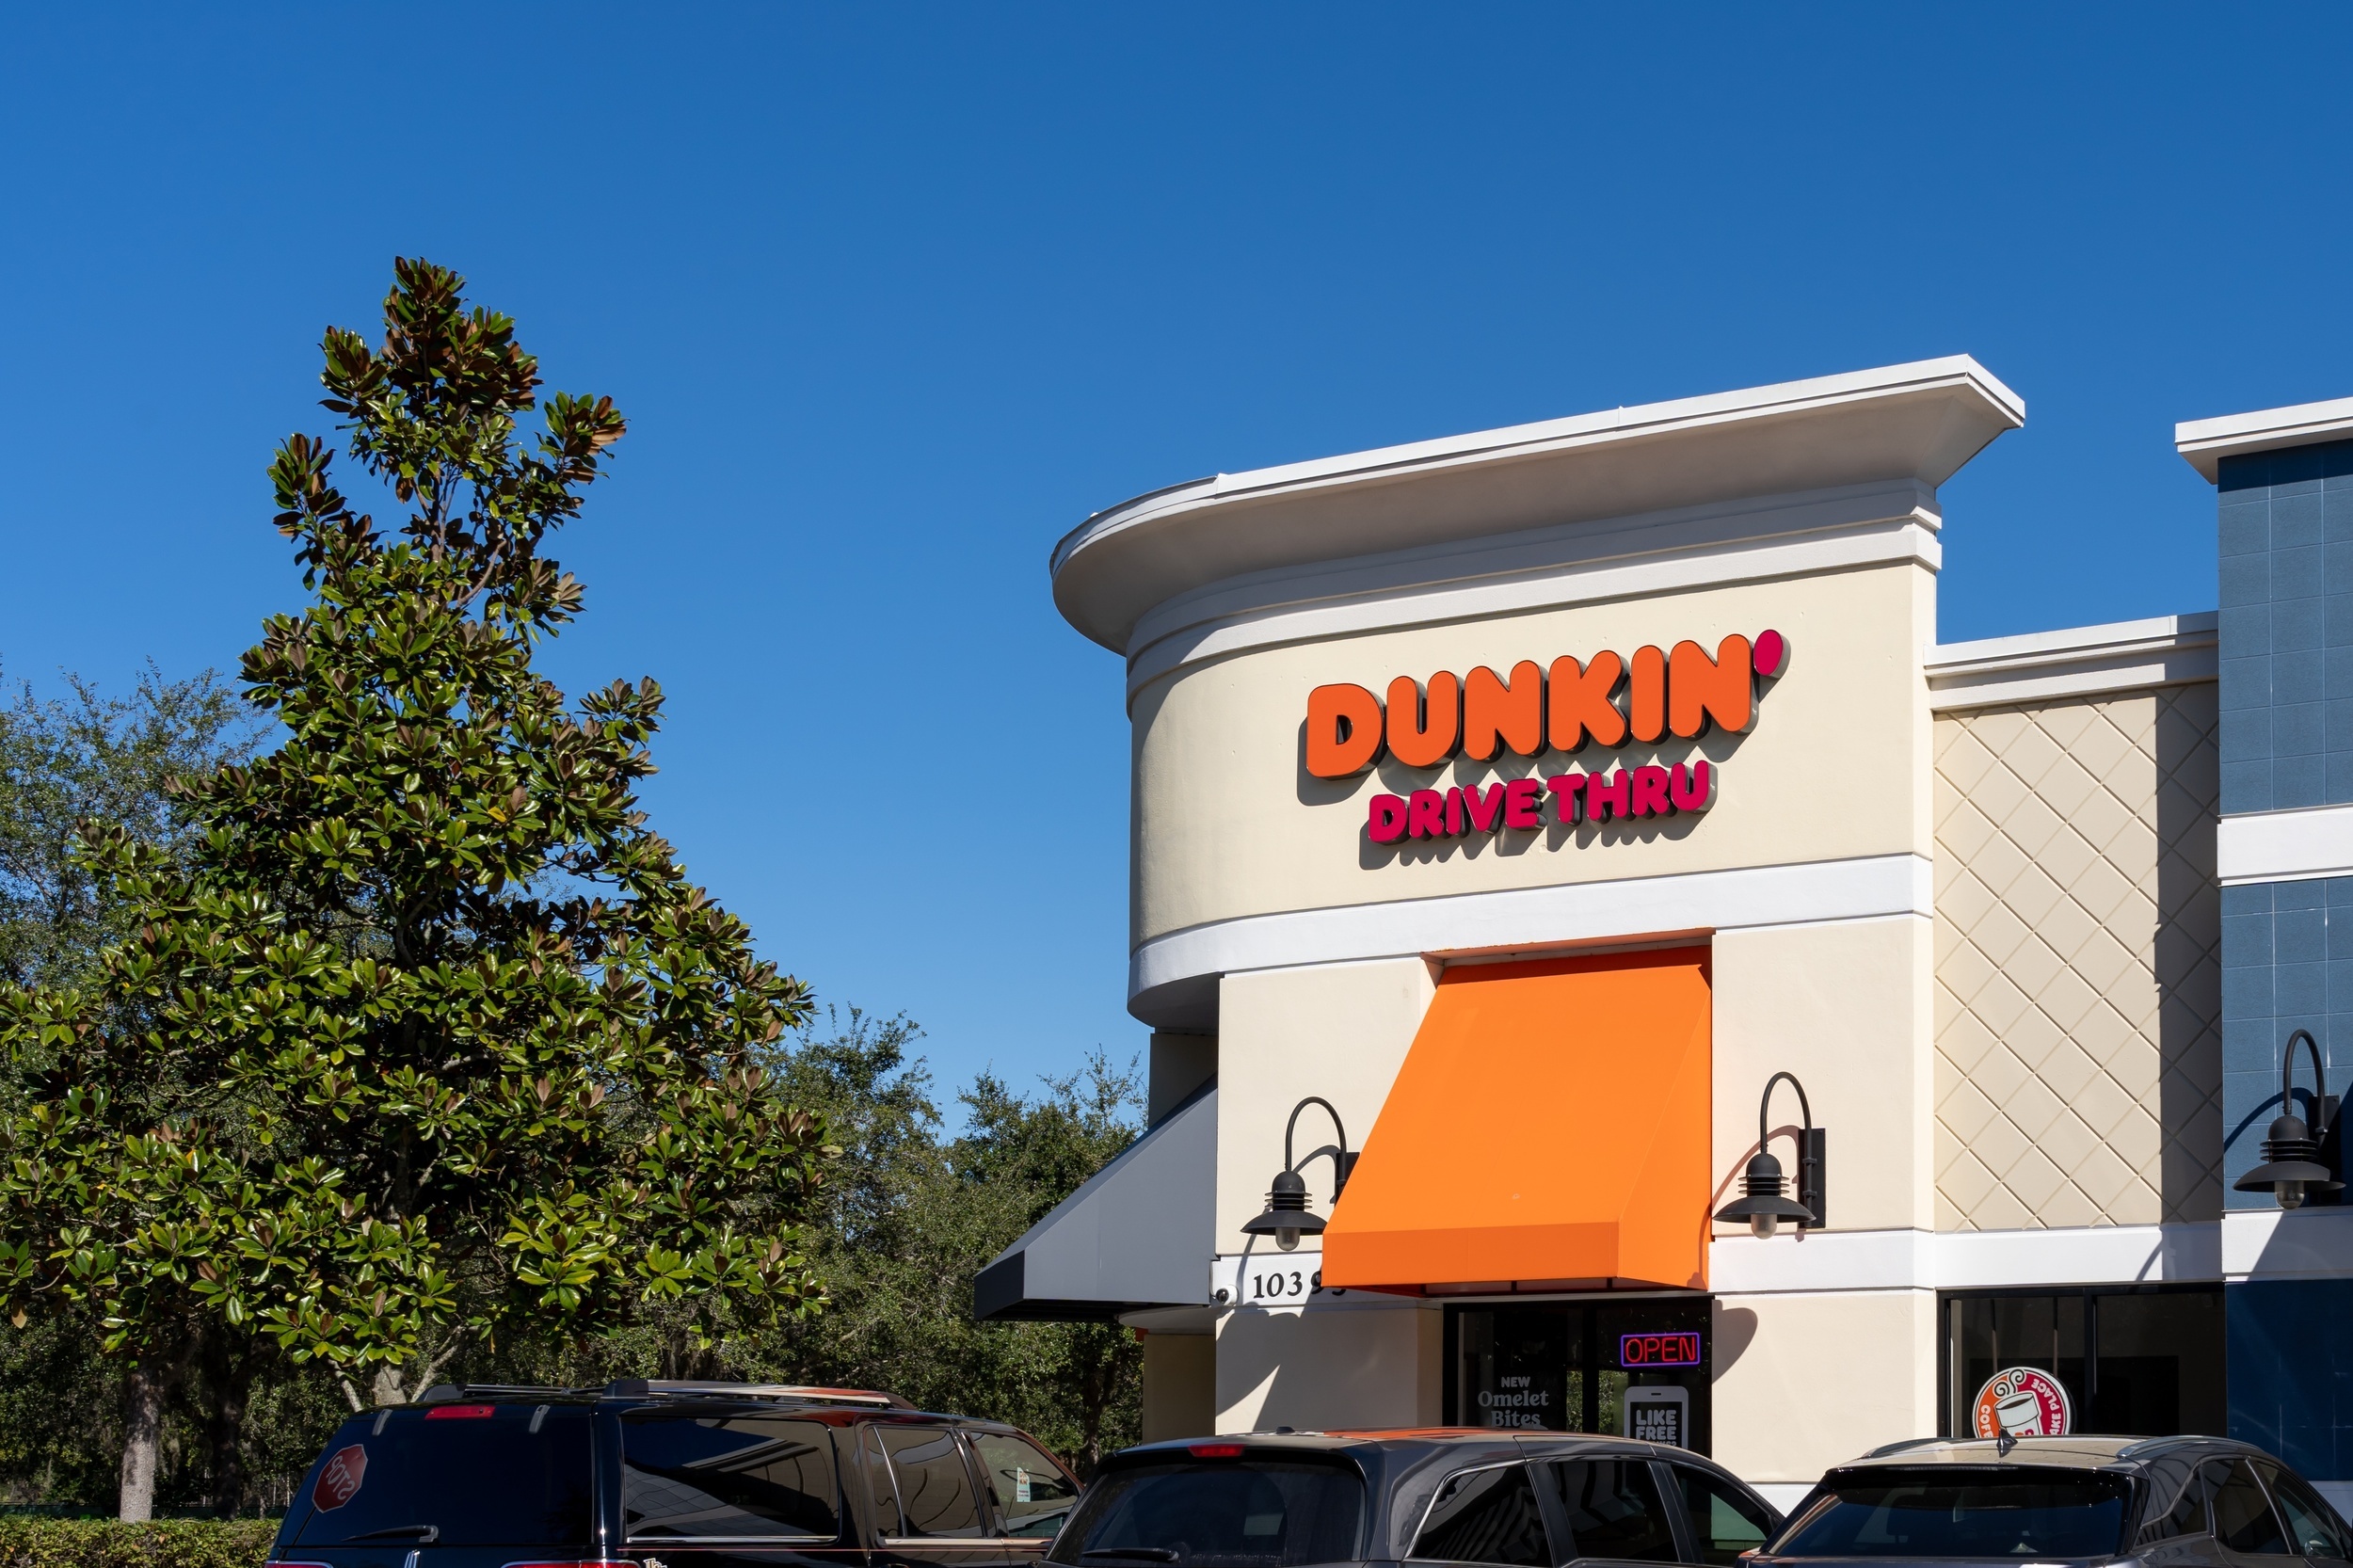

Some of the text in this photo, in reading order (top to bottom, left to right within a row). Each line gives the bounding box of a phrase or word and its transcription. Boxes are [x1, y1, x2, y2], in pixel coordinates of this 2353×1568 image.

[1306, 629, 1786, 779] DUNKIN'
[1369, 760, 1711, 844] DRIVE THRU
[1253, 1271, 1347, 1298] 1039
[1625, 1336, 1697, 1364] OPEN
[1500, 1376, 1531, 1388] NEW
[1478, 1389, 1549, 1407] Omelet
[2030, 1378, 2061, 1435] AKE PLACE
[1491, 1409, 1541, 1427] Bites
[1636, 1409, 1677, 1426] LIKE
[1635, 1426, 1677, 1440] FREE
